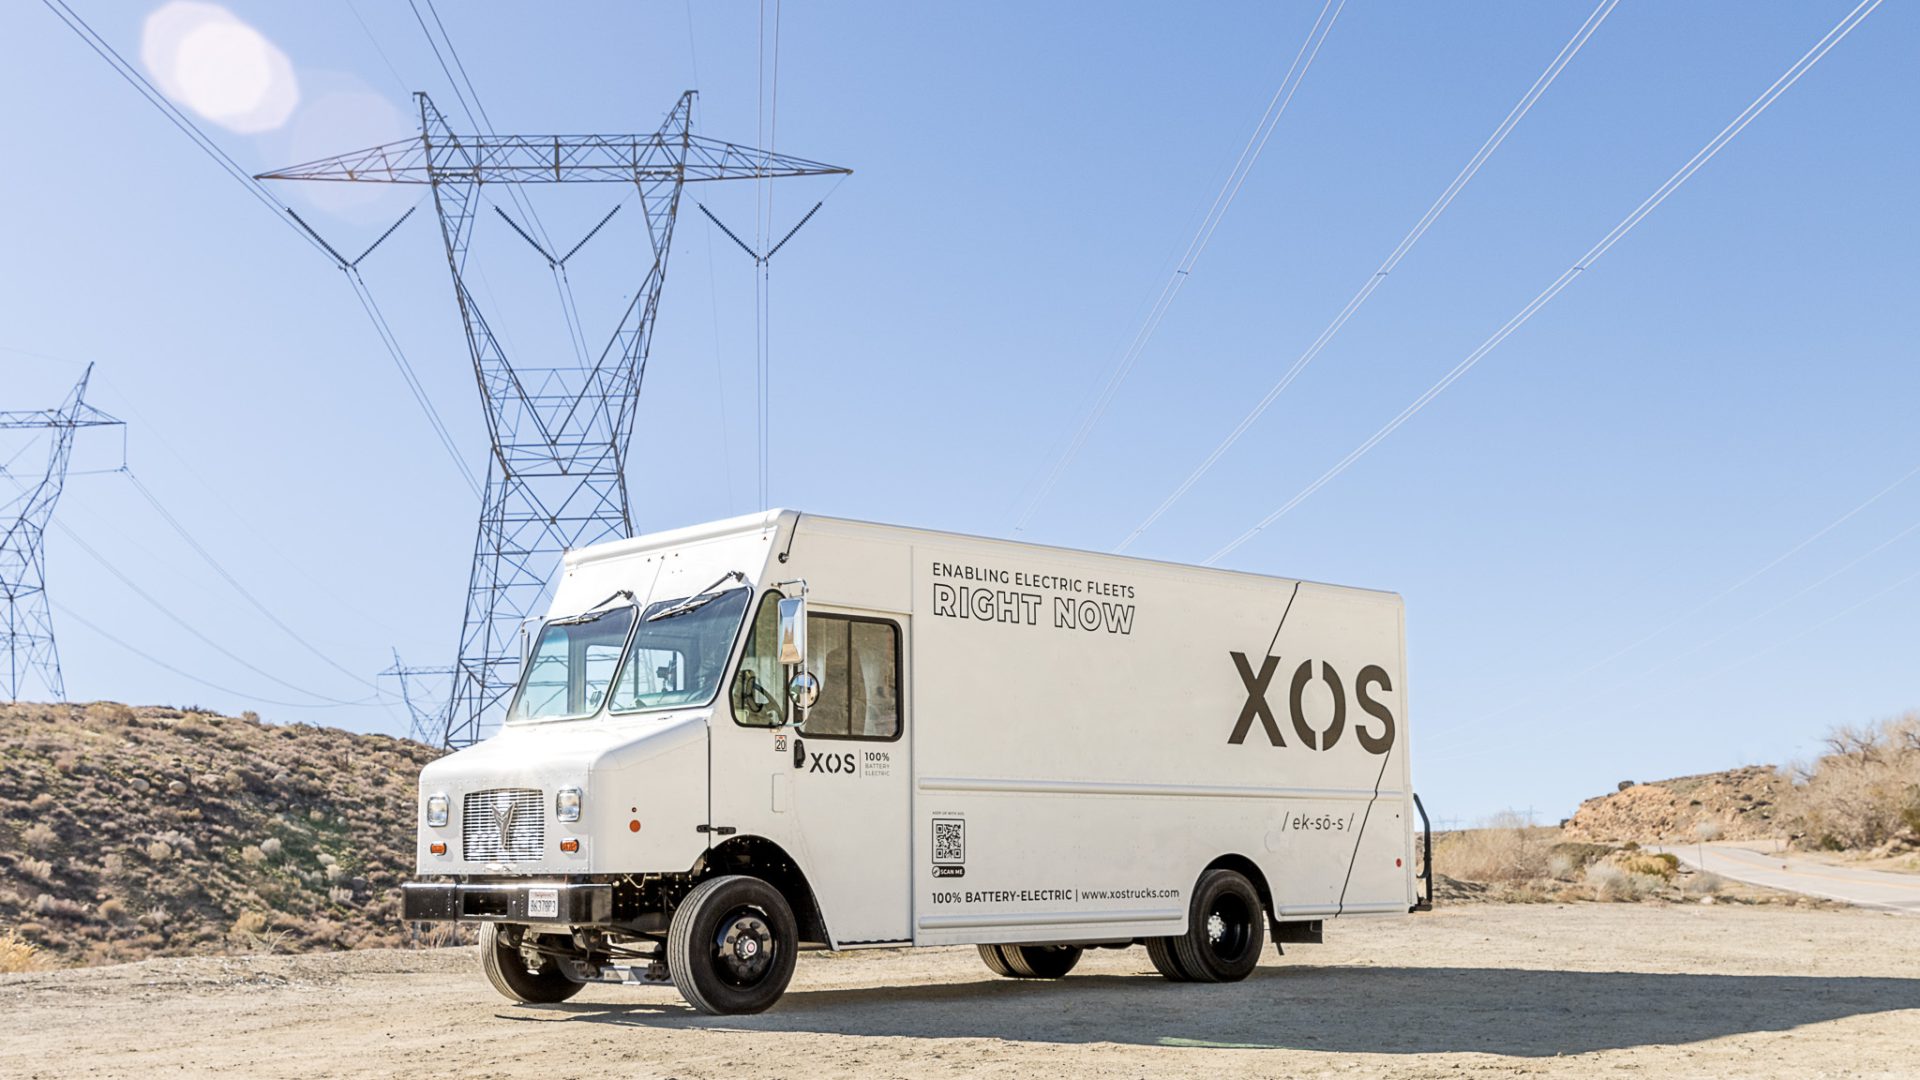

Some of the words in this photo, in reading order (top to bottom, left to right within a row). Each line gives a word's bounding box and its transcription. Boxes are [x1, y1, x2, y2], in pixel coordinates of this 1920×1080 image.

[932, 562, 1010, 584] ENABLING
[1015, 572, 1082, 593] ELECTRIC
[1087, 580, 1136, 599] FLEETS
[933, 583, 1042, 626] RIGHT
[1054, 596, 1136, 635] NOW
[1227, 651, 1396, 755] XOS
[776, 739, 786, 750] 20
[809, 753, 856, 774] XOS
[864, 751, 890, 762] 100%
[931, 892, 962, 904] 100%
[965, 889, 1073, 903] BATTERY-ELECTRIC
[1081, 888, 1180, 900] www.xostrucks.com
